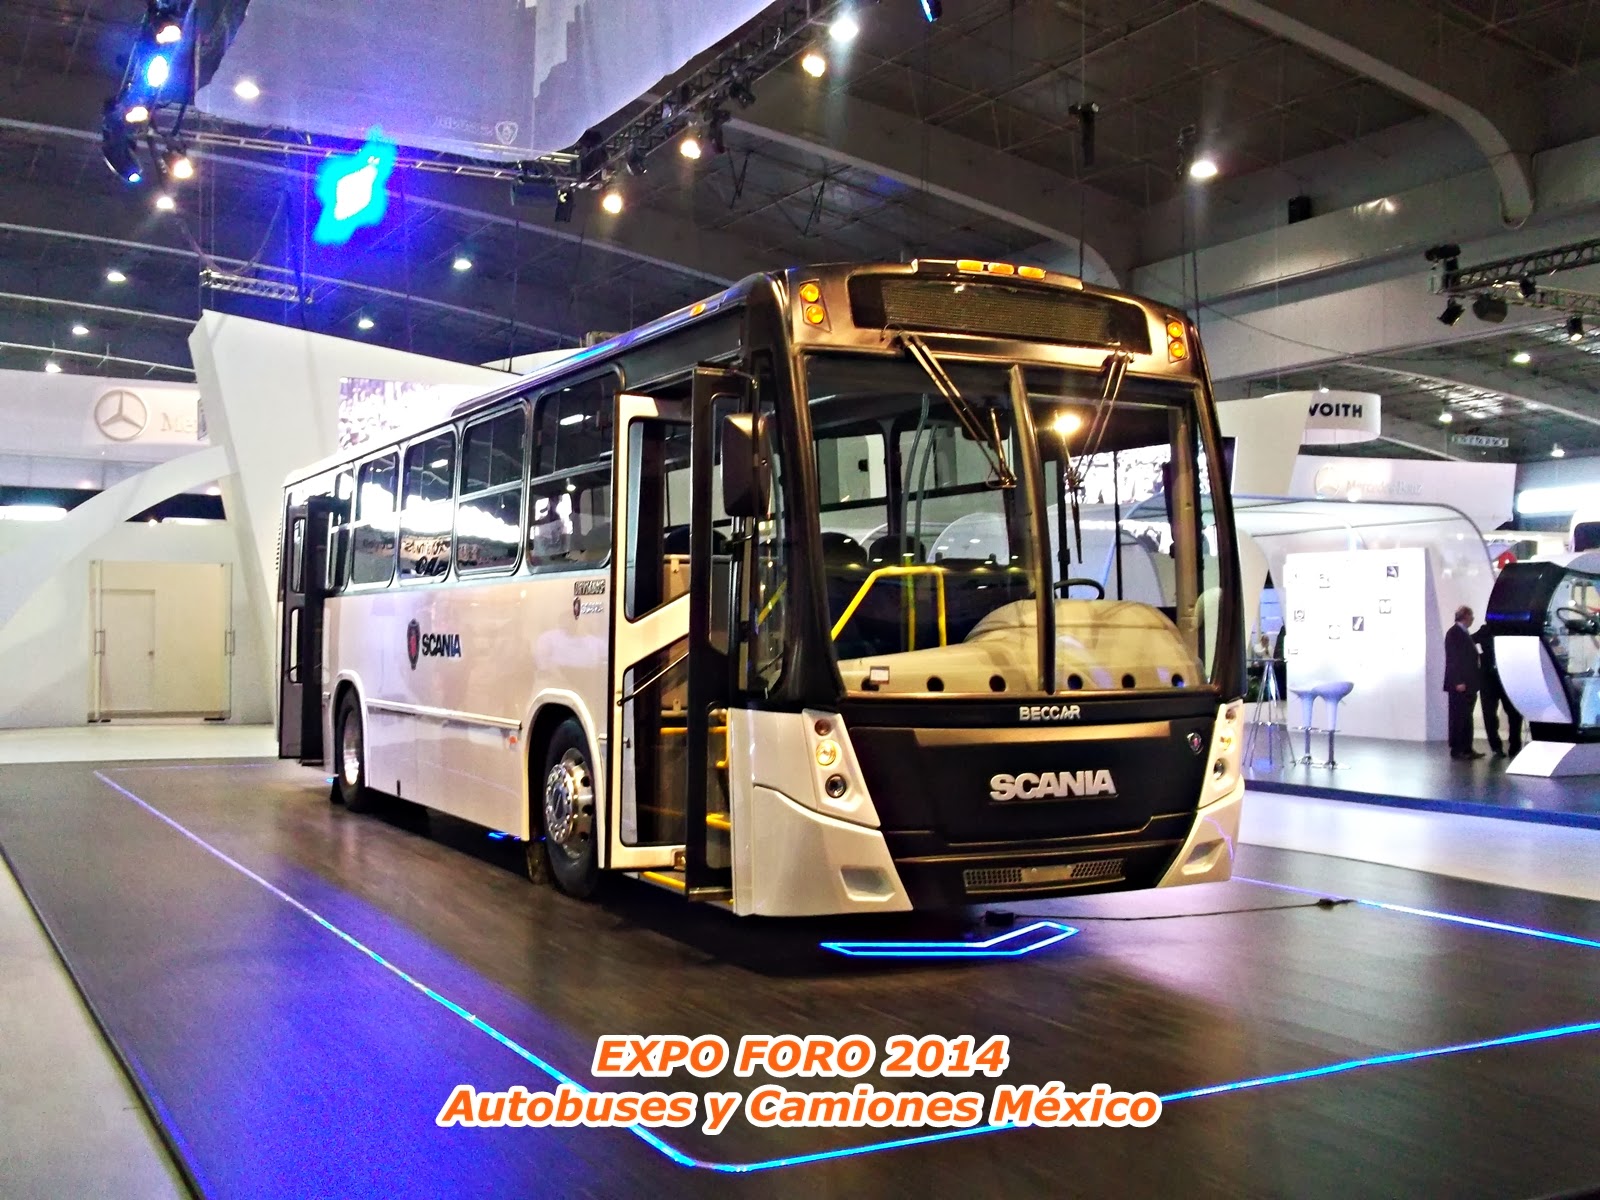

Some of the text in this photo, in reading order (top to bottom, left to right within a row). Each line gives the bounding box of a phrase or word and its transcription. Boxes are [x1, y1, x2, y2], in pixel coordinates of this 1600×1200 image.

[1309, 403, 1362, 418] VOITH
[422, 633, 461, 657] SCANIA
[1019, 705, 1081, 720] BECCAR
[989, 769, 1117, 801] SCANIA
